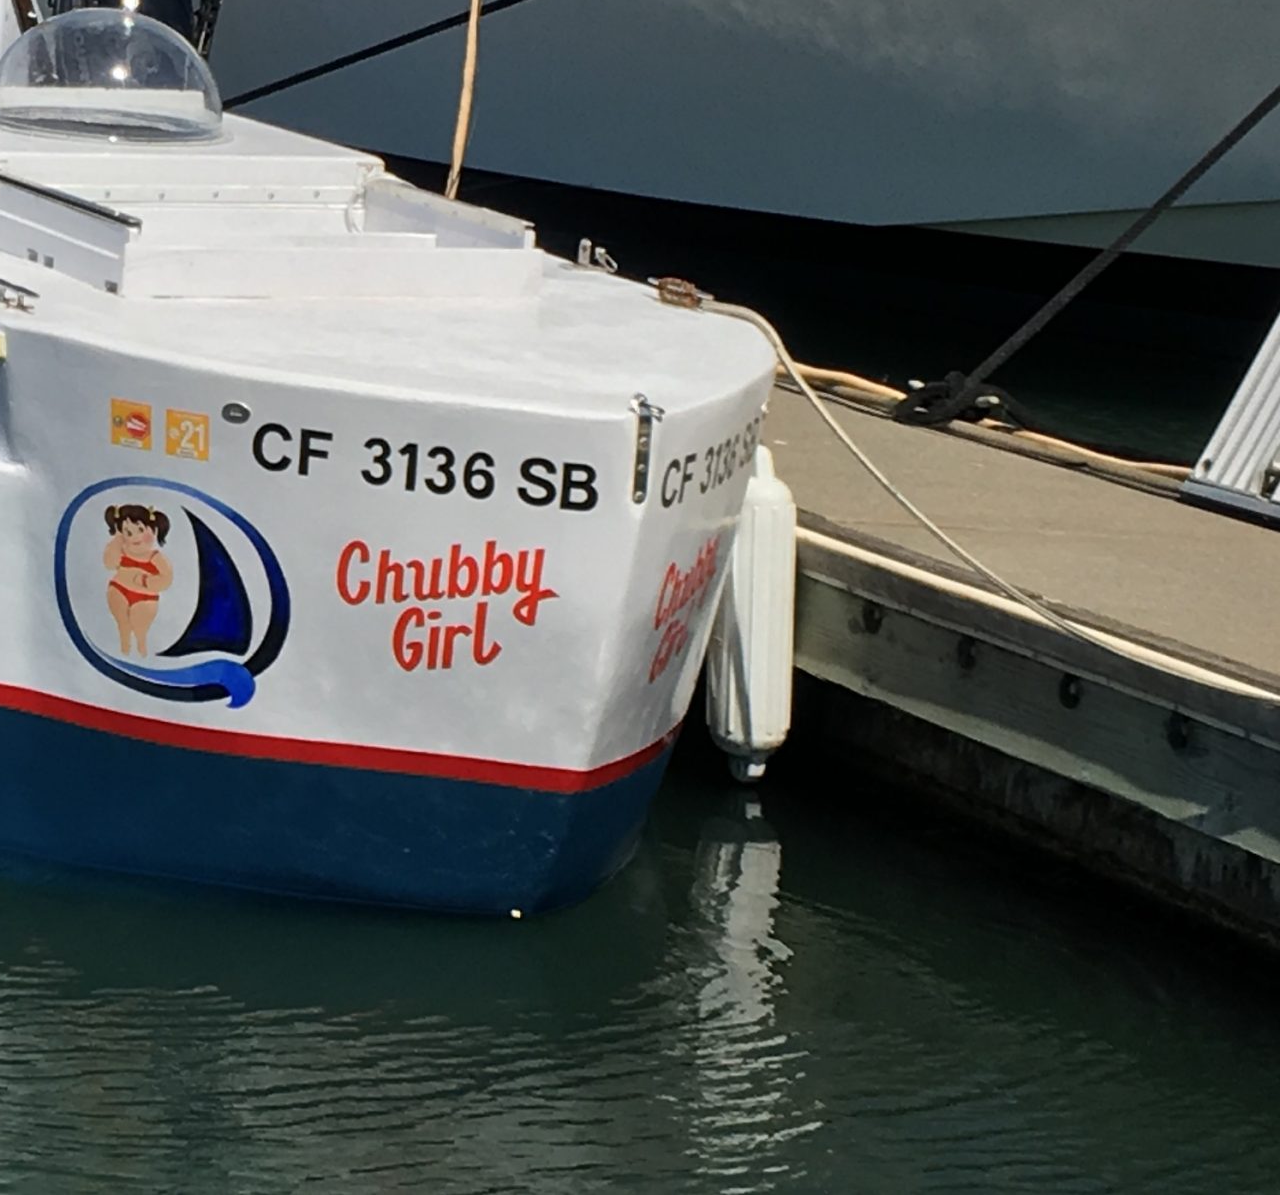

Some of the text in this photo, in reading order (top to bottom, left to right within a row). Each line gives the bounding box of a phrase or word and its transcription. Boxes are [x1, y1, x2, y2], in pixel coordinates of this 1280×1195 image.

[181, 420, 206, 451] 21
[252, 422, 599, 512] CF 3136 SB
[661, 452, 698, 509] CF
[699, 433, 740, 495] 3136
[336, 540, 560, 627] Chubby
[392, 601, 503, 673] Girl
